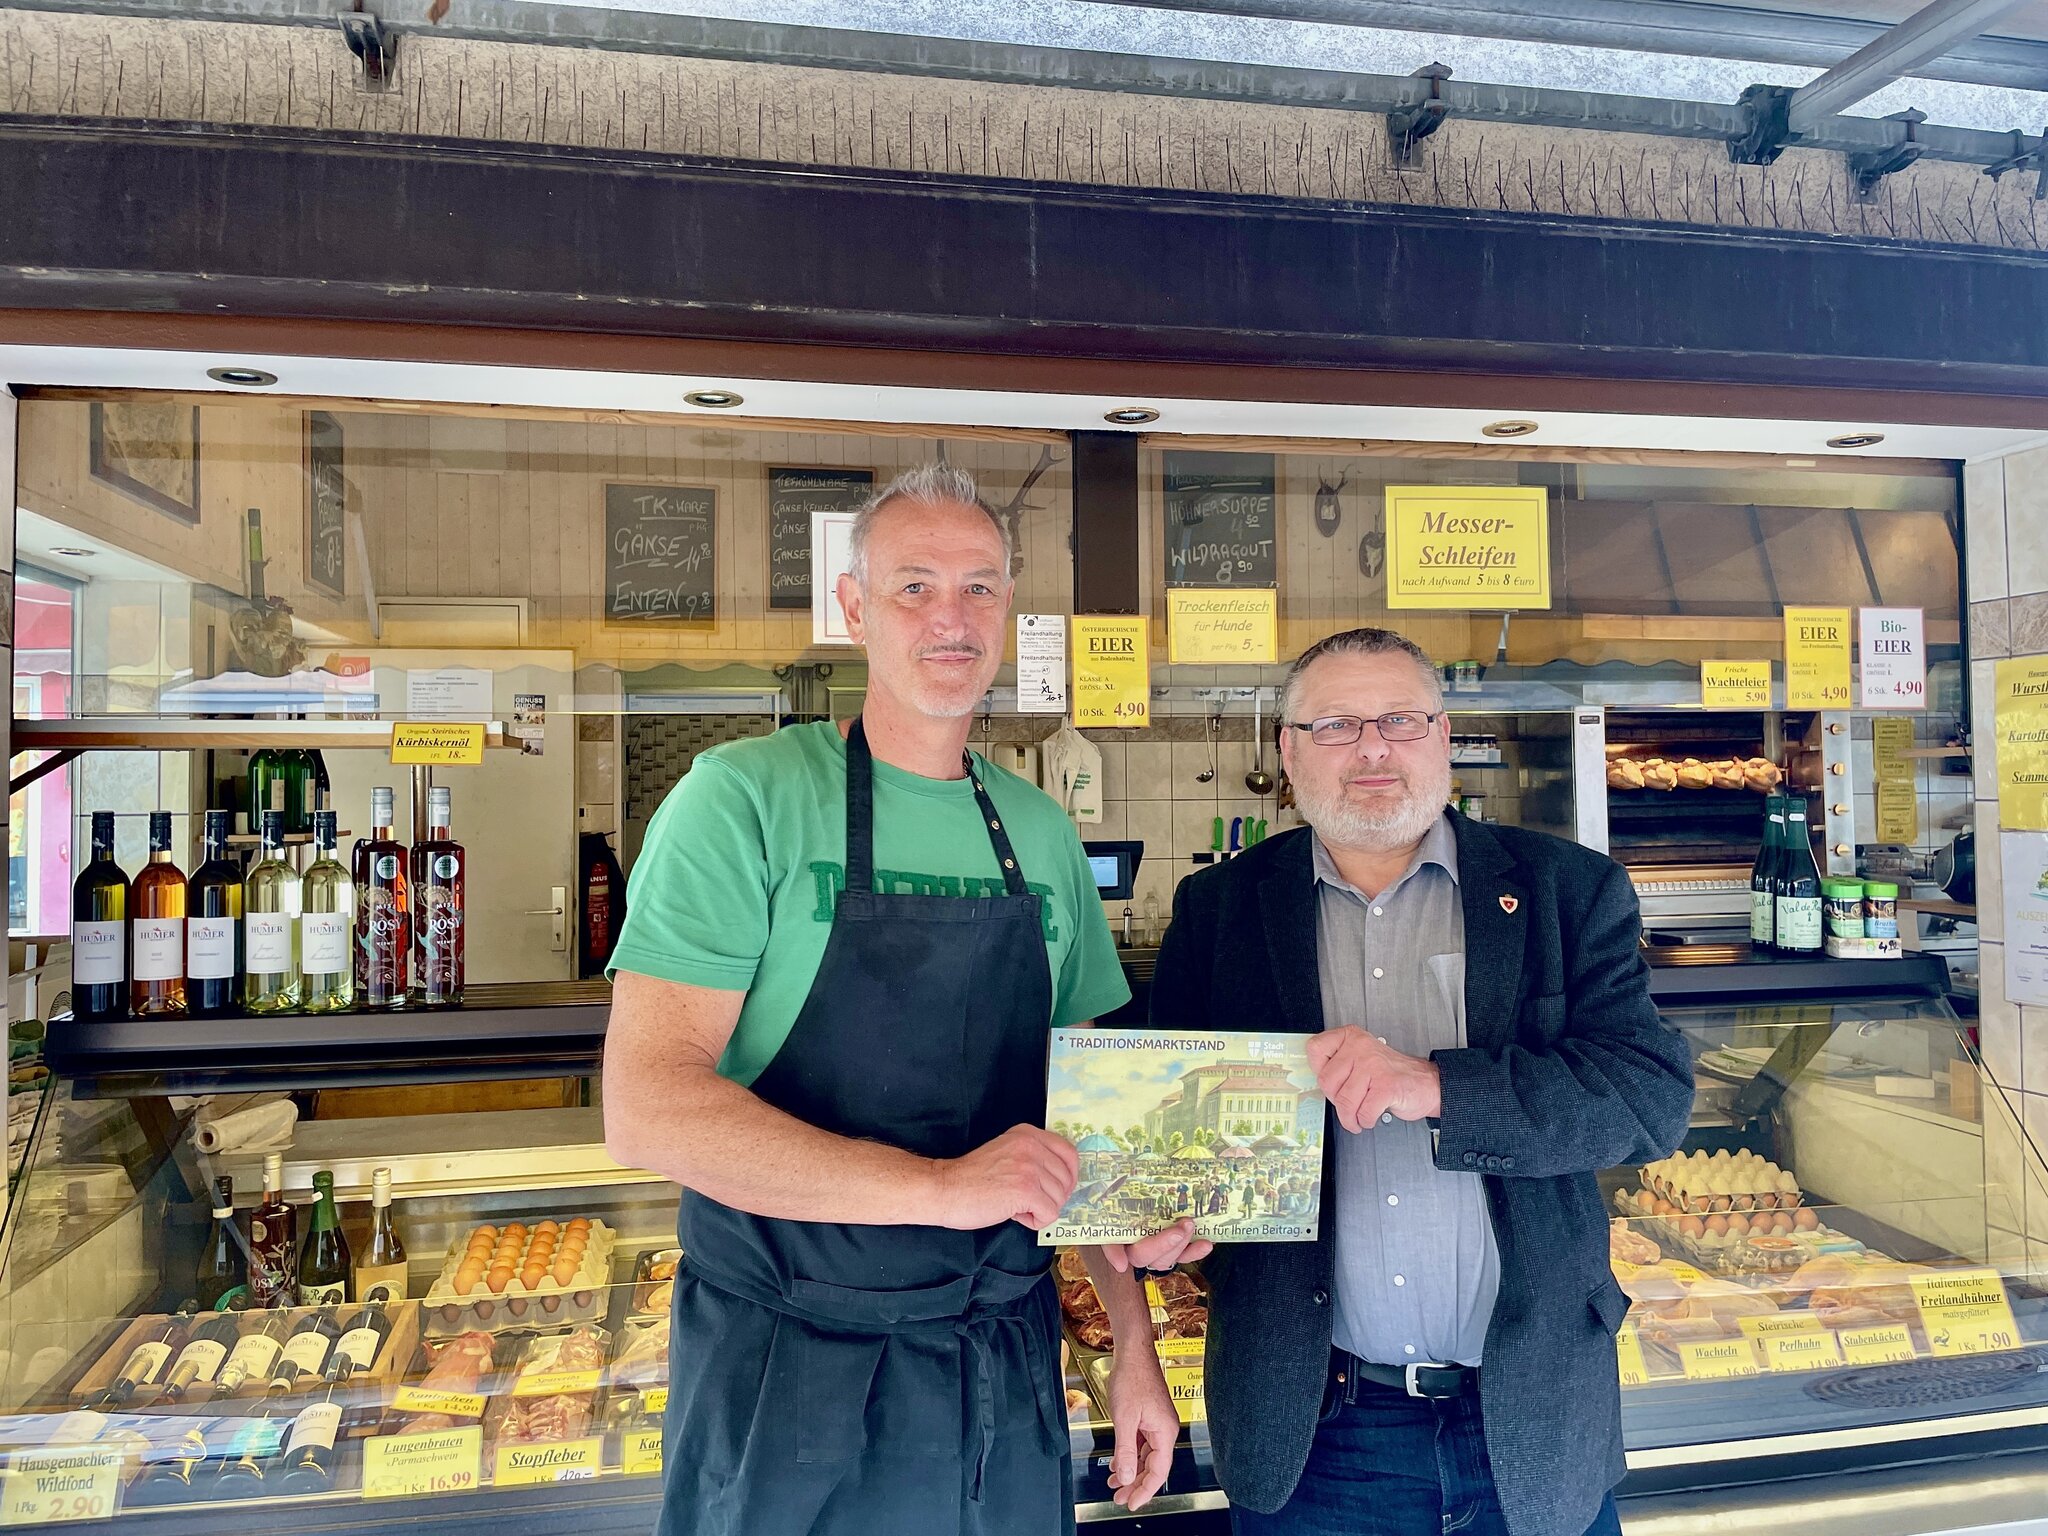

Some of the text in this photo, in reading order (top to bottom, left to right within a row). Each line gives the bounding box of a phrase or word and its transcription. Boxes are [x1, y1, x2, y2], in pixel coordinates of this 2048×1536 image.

[1420, 511, 1514, 534] Messer-
[1171, 540, 1273, 567] WILDRAGOUT
[1419, 546, 1517, 570] Schleifen
[1402, 576, 1426, 586] nach
[1428, 576, 1470, 588] Aufwand
[1476, 574, 1484, 586] 5
[1487, 576, 1500, 586] bis
[1503, 574, 1510, 586] 8
[613, 581, 686, 612] ENTEN
[1177, 600, 1270, 612] Trockenfleisch
[1194, 619, 1253, 632] für Hunde
[1881, 620, 1907, 633] Bio-
[1800, 626, 1838, 640] EIER
[1089, 637, 1134, 652] EIER
[1874, 640, 1912, 653] EIER
[1706, 676, 1767, 687] Wachteleier
[1893, 680, 1922, 697] 4,90
[1041, 685, 1053, 694] XL
[1801, 691, 1815, 699] Stk.
[1821, 687, 1848, 701] 4,90
[1868, 686, 1888, 695] 6 Stk.
[1079, 708, 1106, 717] 10 Stk.
[1114, 702, 1145, 719] 4,90
[396, 737, 470, 747] Kürbiskernöl
[141, 931, 175, 940] HUMER
[192, 931, 224, 939] HUMER
[251, 925, 283, 934] HUMER
[309, 925, 343, 934] HUMER
[81, 934, 115, 943] HUMER
[1069, 1037, 1226, 1051] TRADITIONSMARKTSTAND
[1263, 1041, 1284, 1050] Stadt
[1263, 1050, 1284, 1058] Wien
[1055, 1227, 1077, 1238] Das
[1080, 1226, 1137, 1237] Marktamt
[1214, 1224, 1229, 1236] für
[1231, 1224, 1259, 1236] Ihren
[1262, 1224, 1303, 1237] Beitrag.
[1926, 1276, 1984, 1290] Italienische
[1920, 1292, 2002, 1307] Freilandhühner
[1942, 1309, 1990, 1320] maisgefüttert
[1758, 1319, 1805, 1331] Steirische
[1779, 1338, 1821, 1352] Perlhuhn
[1844, 1331, 1906, 1346] Stubenkücken
[1979, 1332, 2012, 1350] 7,90
[1695, 1346, 1738, 1358] Wachteln
[1963, 1342, 1975, 1352] Kg
[408, 1391, 474, 1403] Kaninchen
[384, 1437, 463, 1454] Lungenbraten
[18, 1451, 114, 1473] Hausgemachter
[509, 1448, 586, 1468] Stopfleber
[36, 1474, 94, 1493] Wildfond
[429, 1471, 472, 1491] 16,99
[47, 1495, 104, 1519] 2.90
